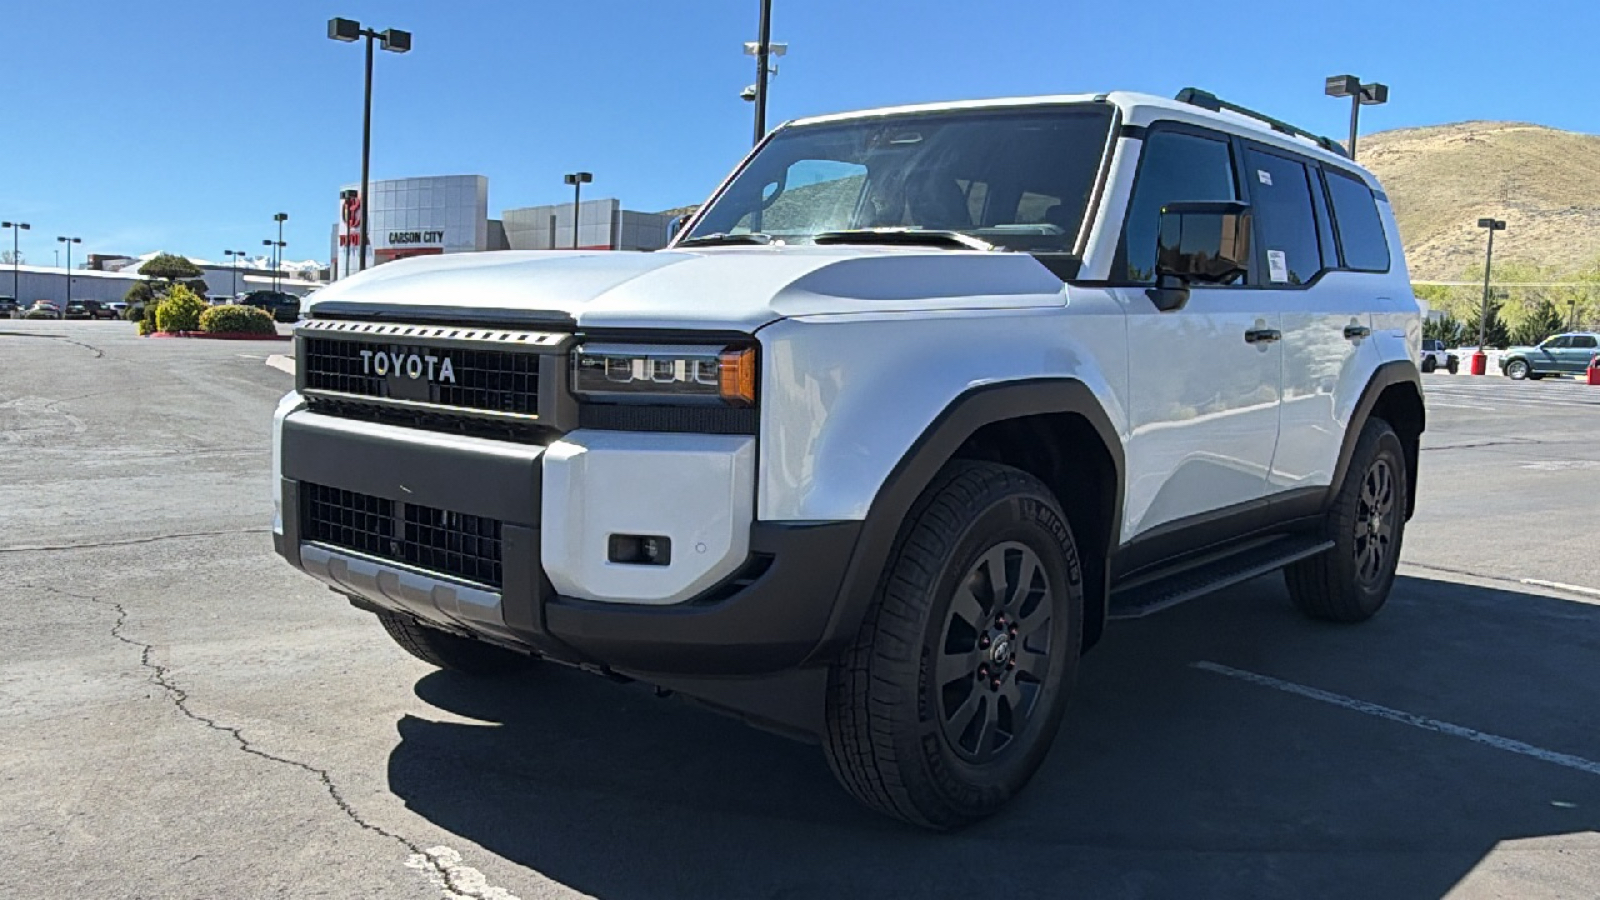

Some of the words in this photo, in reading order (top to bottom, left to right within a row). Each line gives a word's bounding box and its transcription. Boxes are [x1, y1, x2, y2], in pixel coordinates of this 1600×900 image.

[388, 232, 421, 245] CARSON
[424, 230, 444, 243] CITY
[359, 350, 456, 383] TOYOTA
